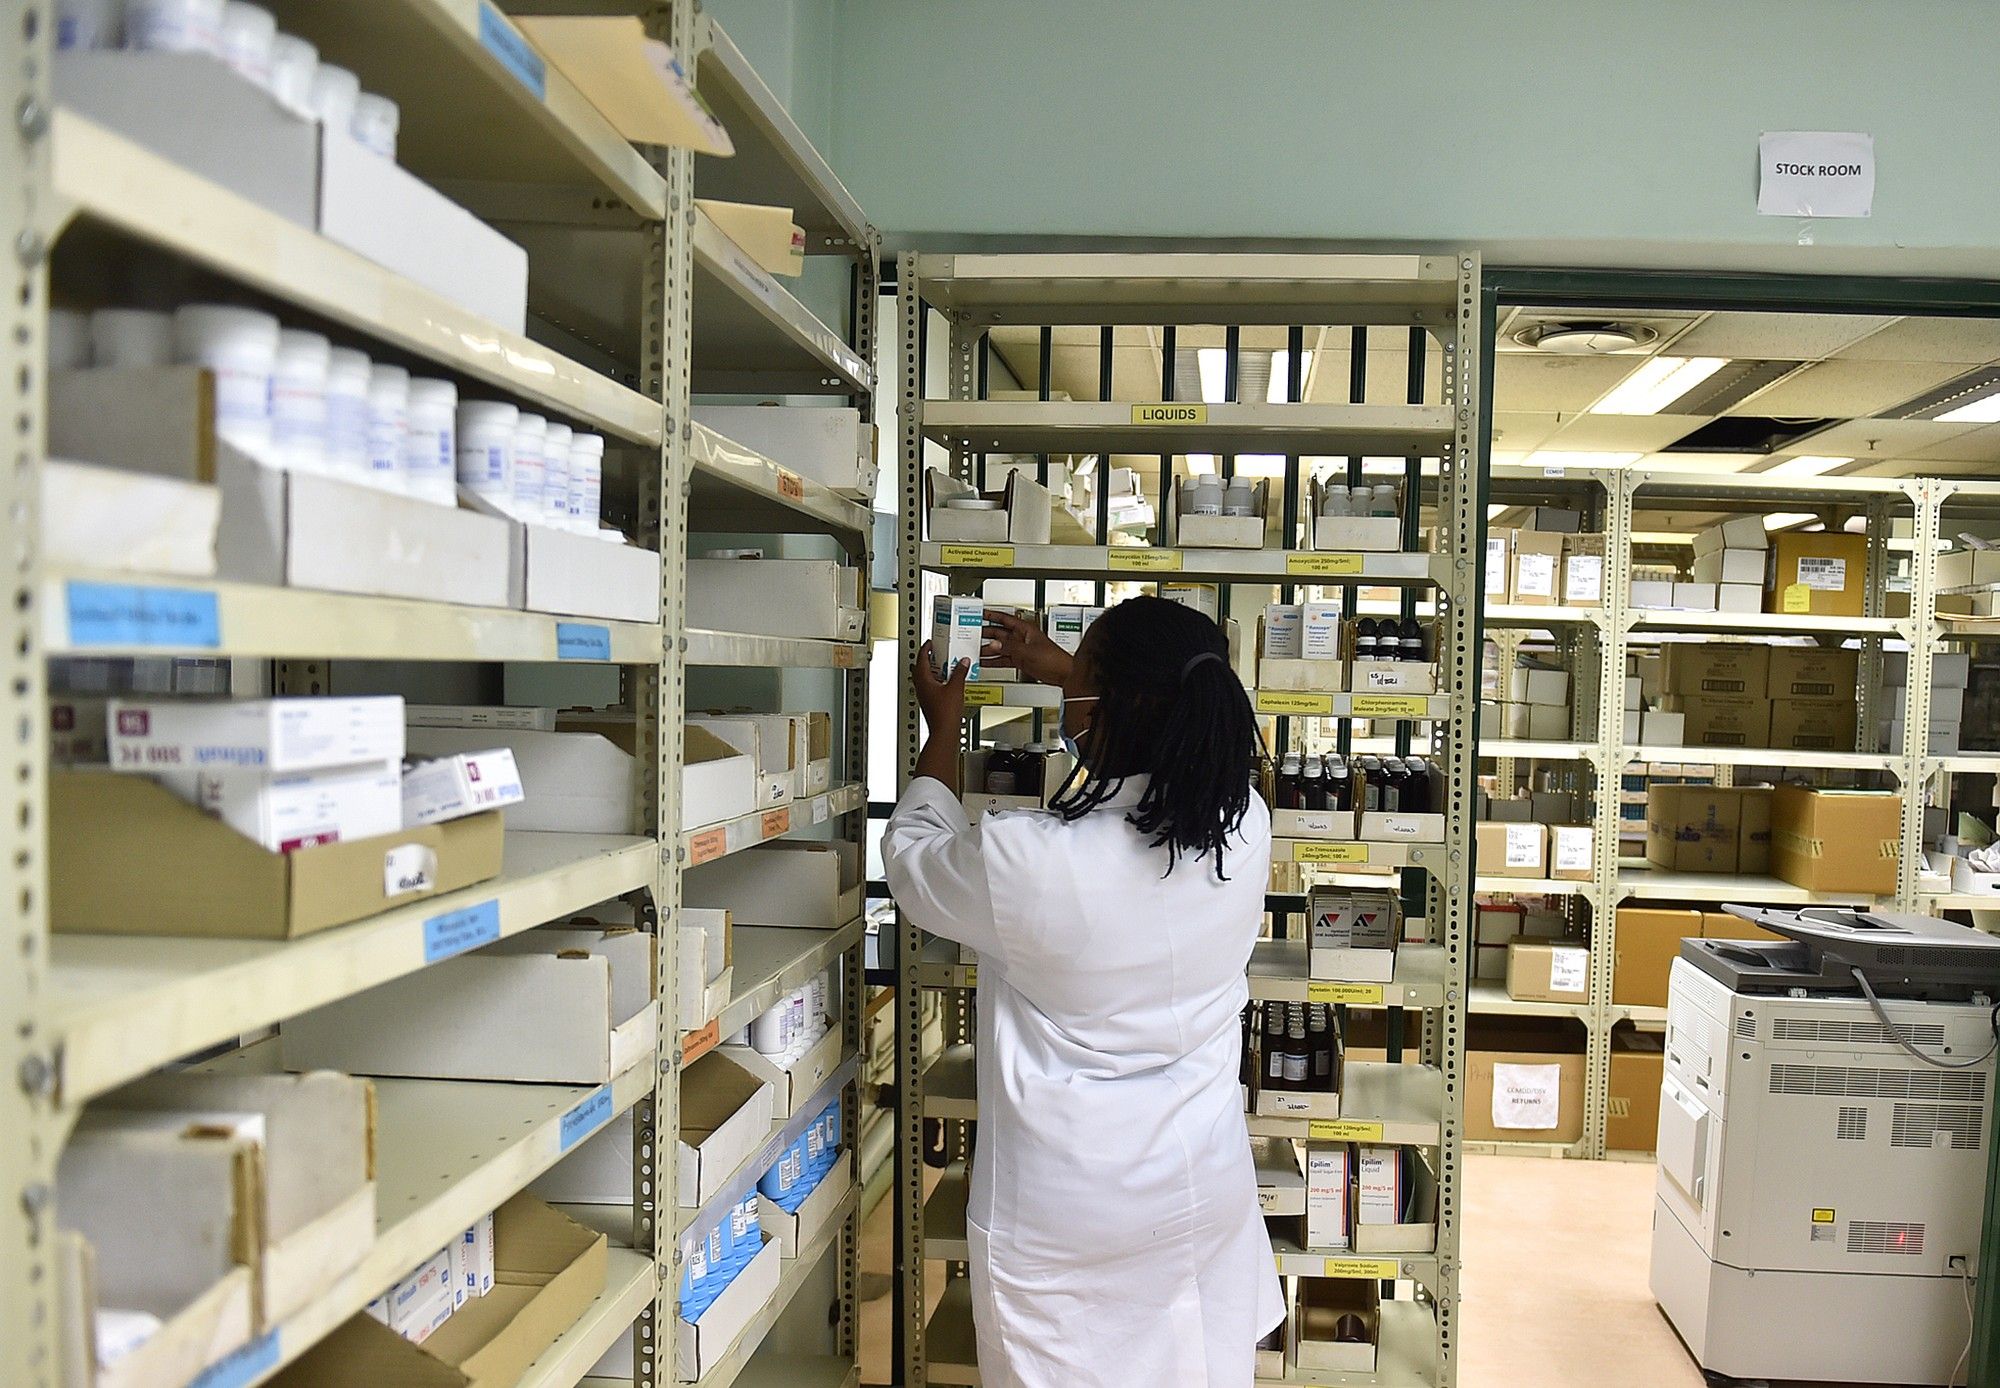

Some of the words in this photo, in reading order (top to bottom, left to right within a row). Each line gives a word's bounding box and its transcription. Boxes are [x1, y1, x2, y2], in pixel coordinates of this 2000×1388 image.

[1776, 163, 1815, 176] STOCK
[1818, 165, 1862, 176] ROOM
[1143, 409, 1197, 420] LIQUIDS
[1291, 699, 1319, 707] 125mg/5ml
[1310, 1160, 1332, 1168] Epilim
[1361, 1158, 1382, 1167] Epilim
